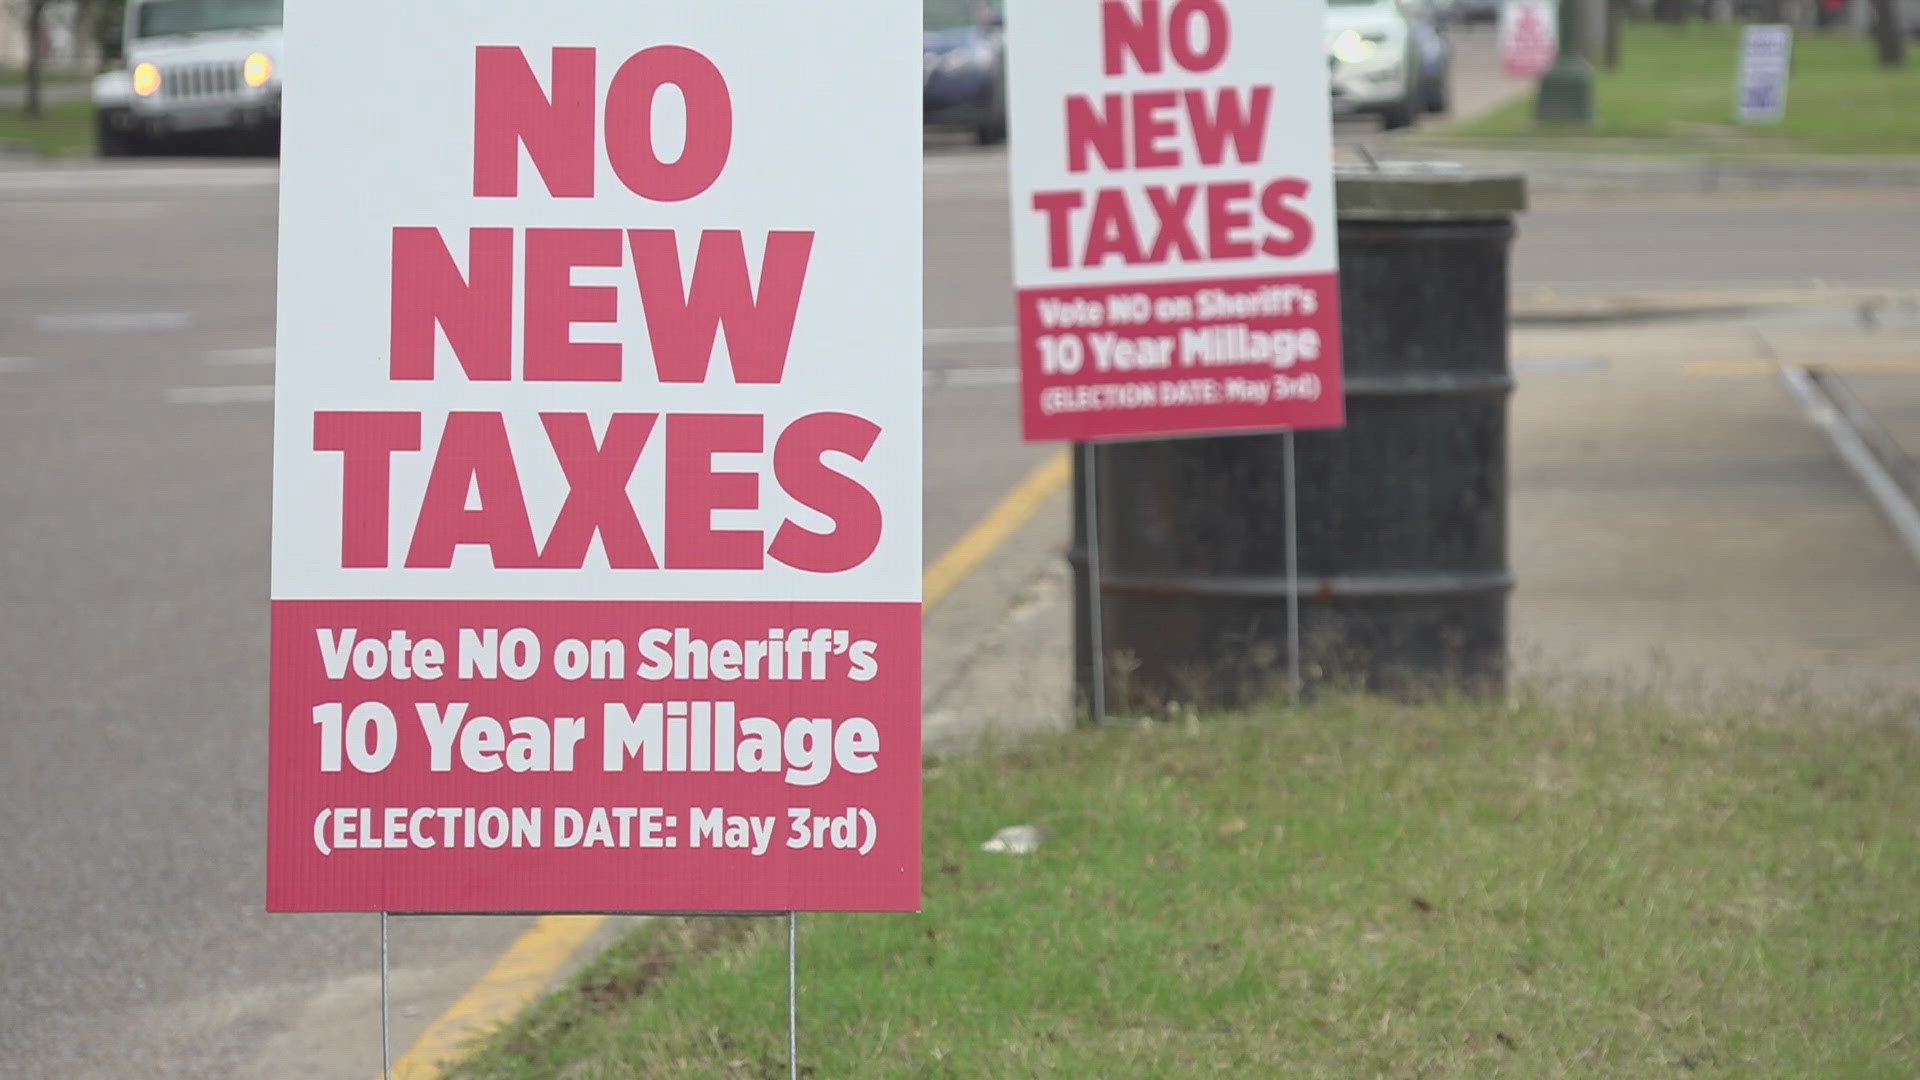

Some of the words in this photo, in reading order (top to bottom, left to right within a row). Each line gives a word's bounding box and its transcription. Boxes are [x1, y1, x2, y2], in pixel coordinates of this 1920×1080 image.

[1102, 0, 1229, 75] NO
[473, 46, 732, 202] NO
[1066, 86, 1272, 172] NEW
[1032, 178, 1313, 269] TAXES
[390, 227, 815, 383] NEW
[1037, 296, 1104, 328] Vote
[1108, 293, 1152, 324] NO
[1155, 295, 1193, 321] on
[1037, 334, 1084, 373] 10
[1089, 331, 1175, 371] Year
[1179, 324, 1320, 368] Millage
[1040, 383, 1157, 414] (ELECTION
[1225, 379, 1269, 404] May
[1274, 373, 1321, 401] 3rd)
[313, 411, 882, 573] TAXES
[316, 629, 444, 679] Vote
[459, 628, 540, 680] NO
[554, 639, 624, 680] on
[313, 702, 397, 773] 10
[415, 703, 585, 772] Year
[604, 701, 879, 785] Millage
[314, 807, 541, 855] (ELECTION
[554, 807, 677, 847] DATE:
[690, 808, 775, 855] May
[787, 807, 876, 855] 3rd)
